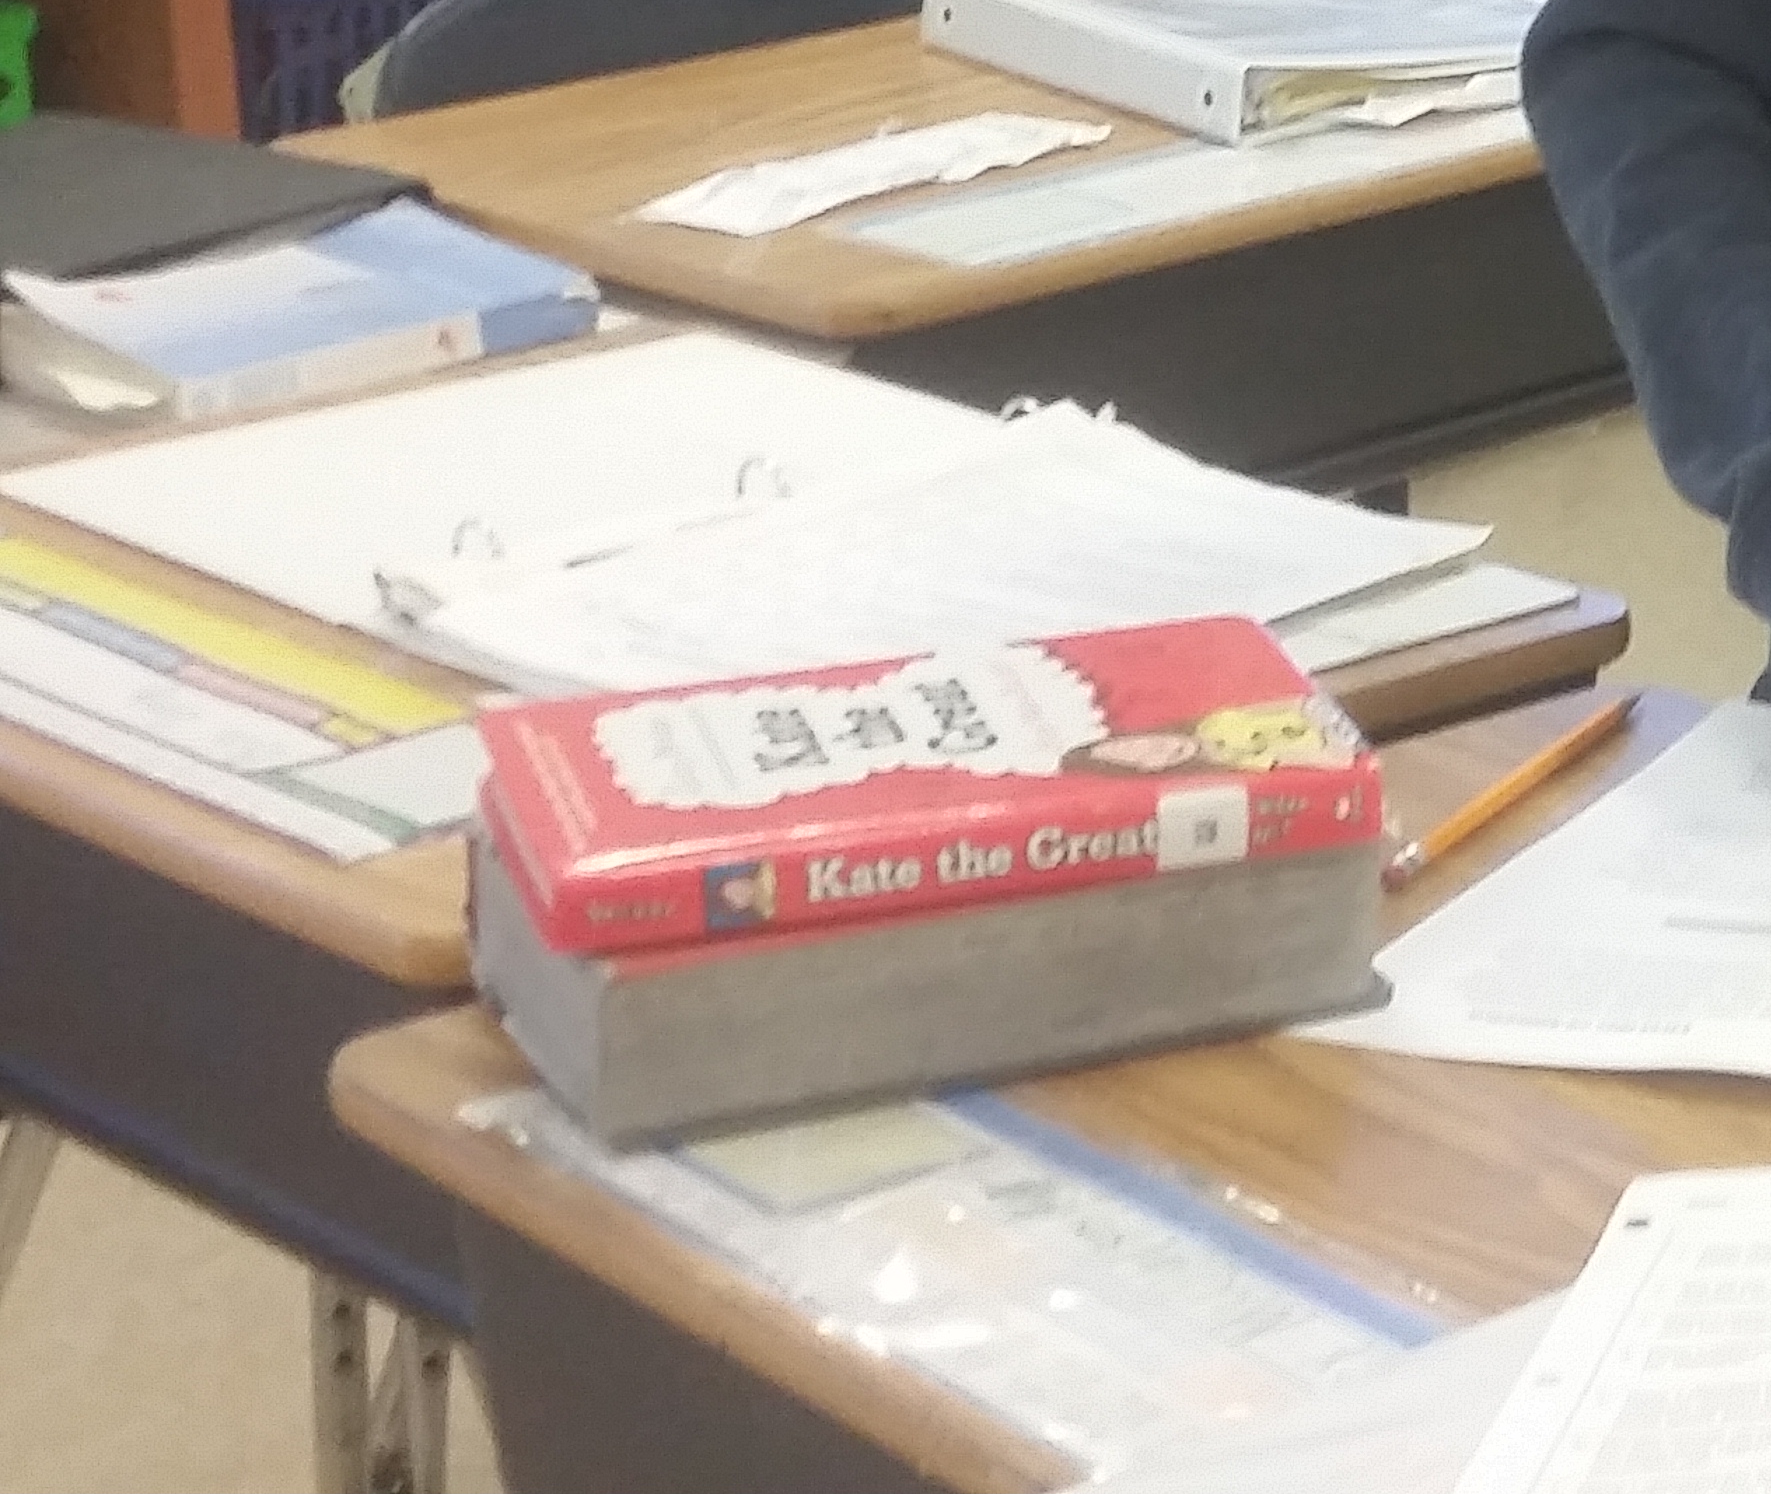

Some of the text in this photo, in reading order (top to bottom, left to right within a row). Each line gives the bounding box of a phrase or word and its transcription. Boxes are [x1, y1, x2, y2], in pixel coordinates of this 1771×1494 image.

[806, 818, 1158, 902] Kate the Great
